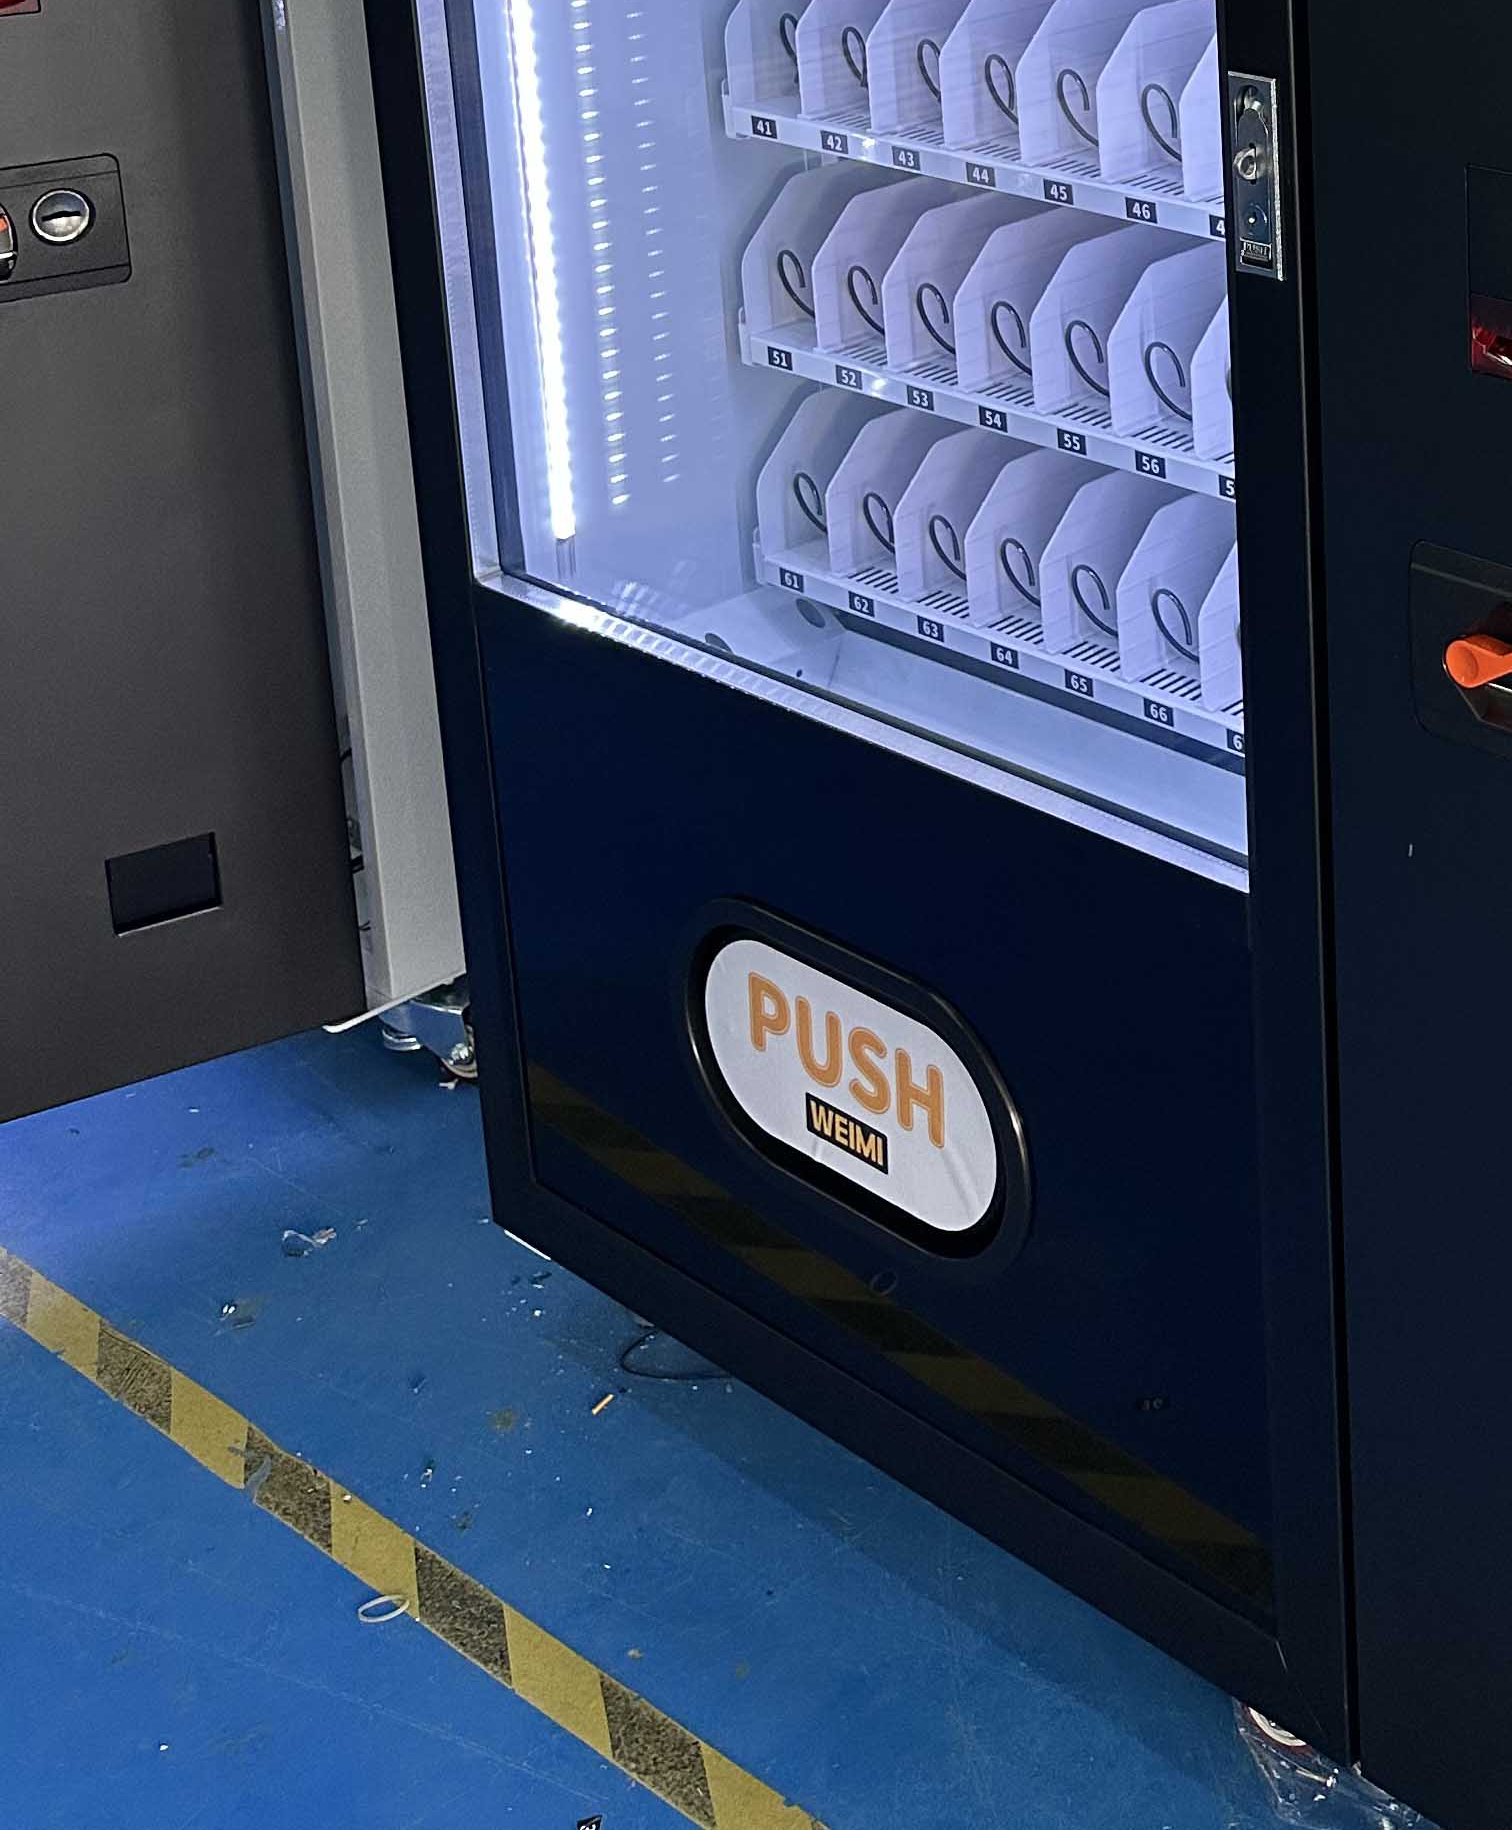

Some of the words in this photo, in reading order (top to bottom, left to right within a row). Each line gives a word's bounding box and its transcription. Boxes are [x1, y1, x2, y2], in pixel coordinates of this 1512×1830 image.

[756, 119, 772, 136] 41
[826, 134, 843, 151] 42
[898, 150, 915, 167] 43
[971, 166, 989, 183] 44
[1049, 184, 1067, 200] 45
[1132, 201, 1150, 219] 46
[772, 351, 789, 367] 51
[840, 369, 857, 386] 52
[912, 389, 929, 407] 53
[984, 410, 1002, 428] 54
[1063, 433, 1081, 451] 55
[1141, 455, 1160, 474] 56
[783, 571, 800, 589] 61
[852, 596, 870, 613] 62
[922, 621, 939, 638] 63
[995, 646, 1013, 664] 64
[1070, 675, 1088, 693] 65
[1149, 703, 1168, 722] 66
[747, 970, 945, 1149] PUSH
[809, 1099, 884, 1167] WEIMI
